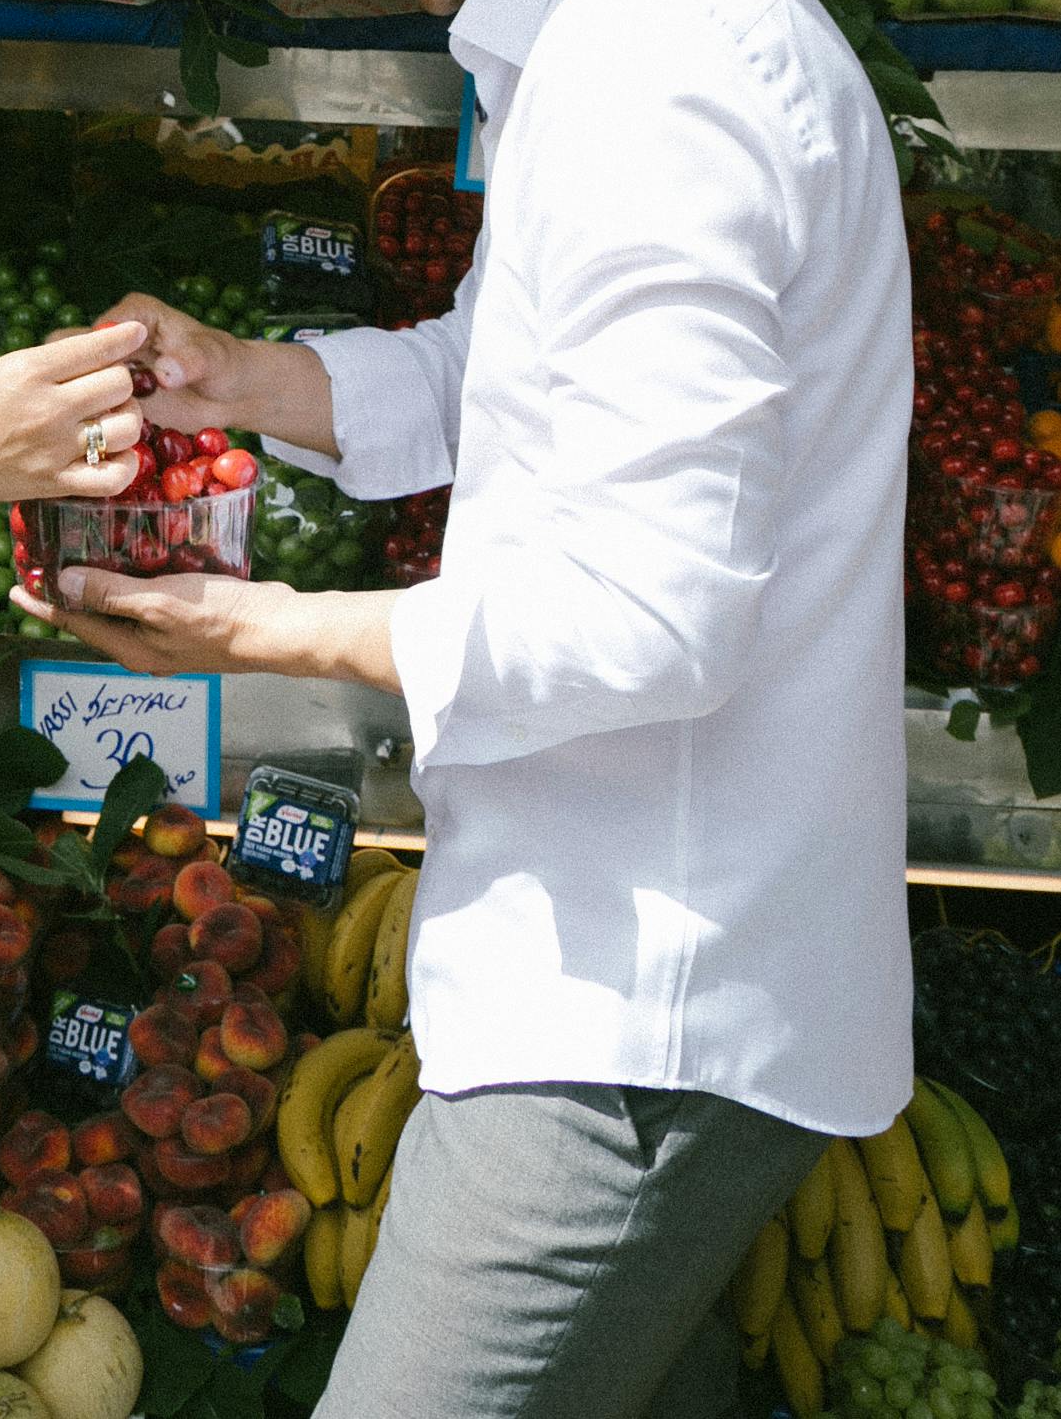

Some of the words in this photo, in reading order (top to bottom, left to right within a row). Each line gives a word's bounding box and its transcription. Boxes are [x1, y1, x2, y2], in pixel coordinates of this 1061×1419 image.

[282, 233, 300, 253] DR
[300, 235, 356, 265] BLUE
[245, 811, 268, 844] DR
[263, 818, 331, 862] BLUE
[49, 1015, 68, 1045] DR
[64, 1019, 123, 1061] BLUE
